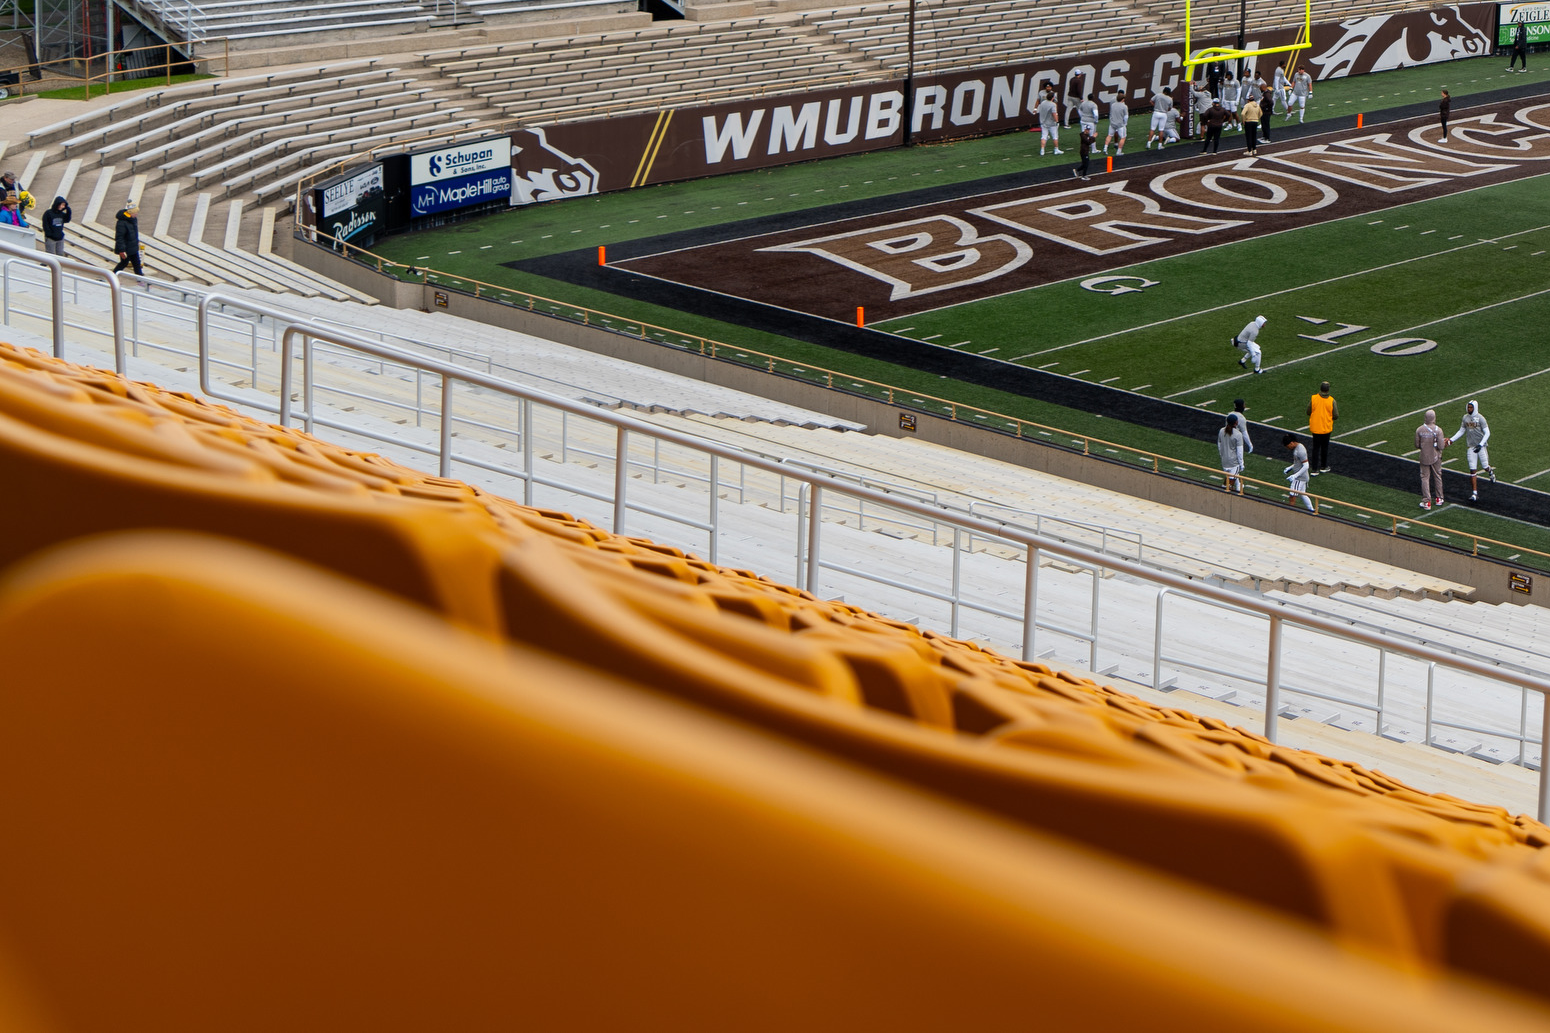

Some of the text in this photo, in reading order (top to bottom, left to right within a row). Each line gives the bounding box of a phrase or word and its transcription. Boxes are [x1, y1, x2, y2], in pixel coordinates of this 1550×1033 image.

[1509, 24, 1550, 37] BNSON
[445, 149, 493, 166] Schupan
[492, 176, 506, 185] auto
[492, 182, 511, 194] group
[325, 179, 355, 205] SEELYE
[332, 210, 376, 251] Radisson
